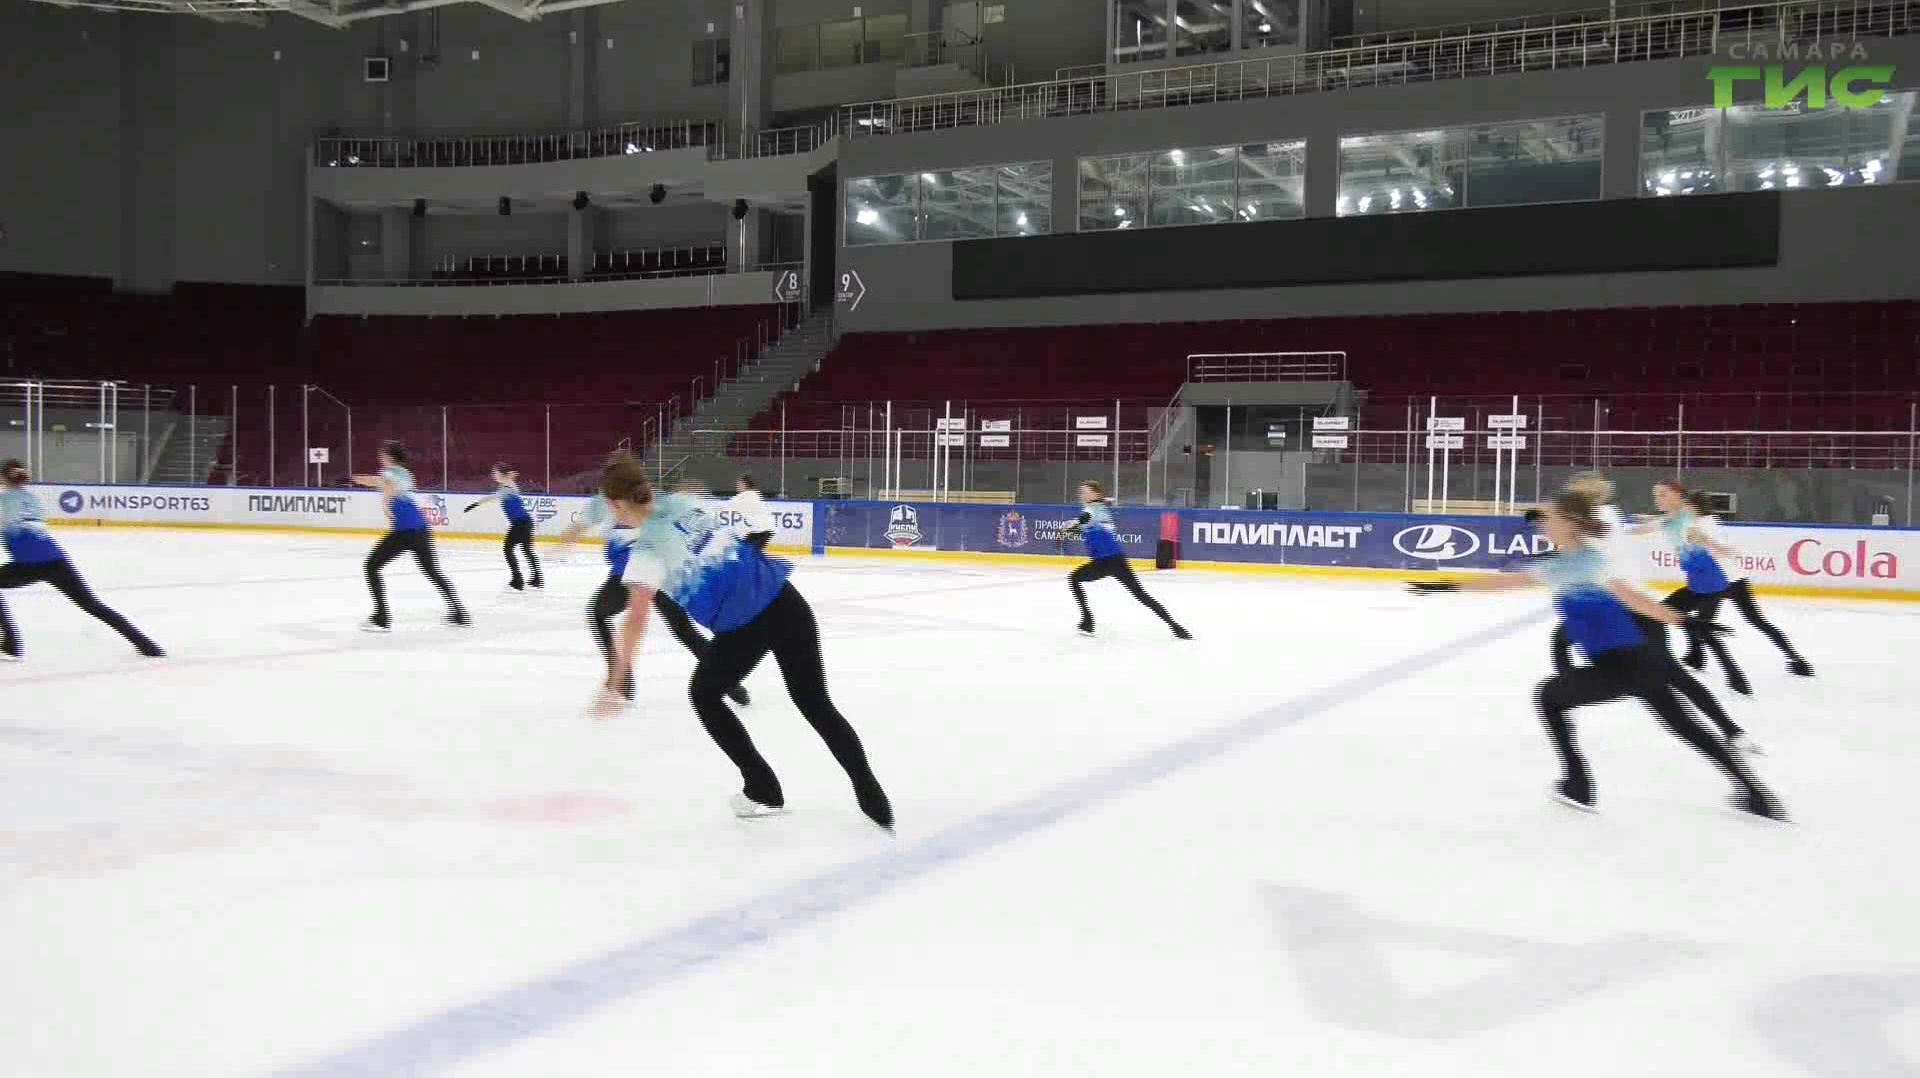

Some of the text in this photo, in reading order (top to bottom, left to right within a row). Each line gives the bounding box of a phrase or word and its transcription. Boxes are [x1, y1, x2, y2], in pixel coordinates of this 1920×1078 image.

[789, 272, 798, 290] 8
[842, 273, 851, 292] 9
[90, 495, 210, 511] MINSPORT63
[1488, 533, 1555, 555] LAD
[1787, 538, 1897, 579] Cola
